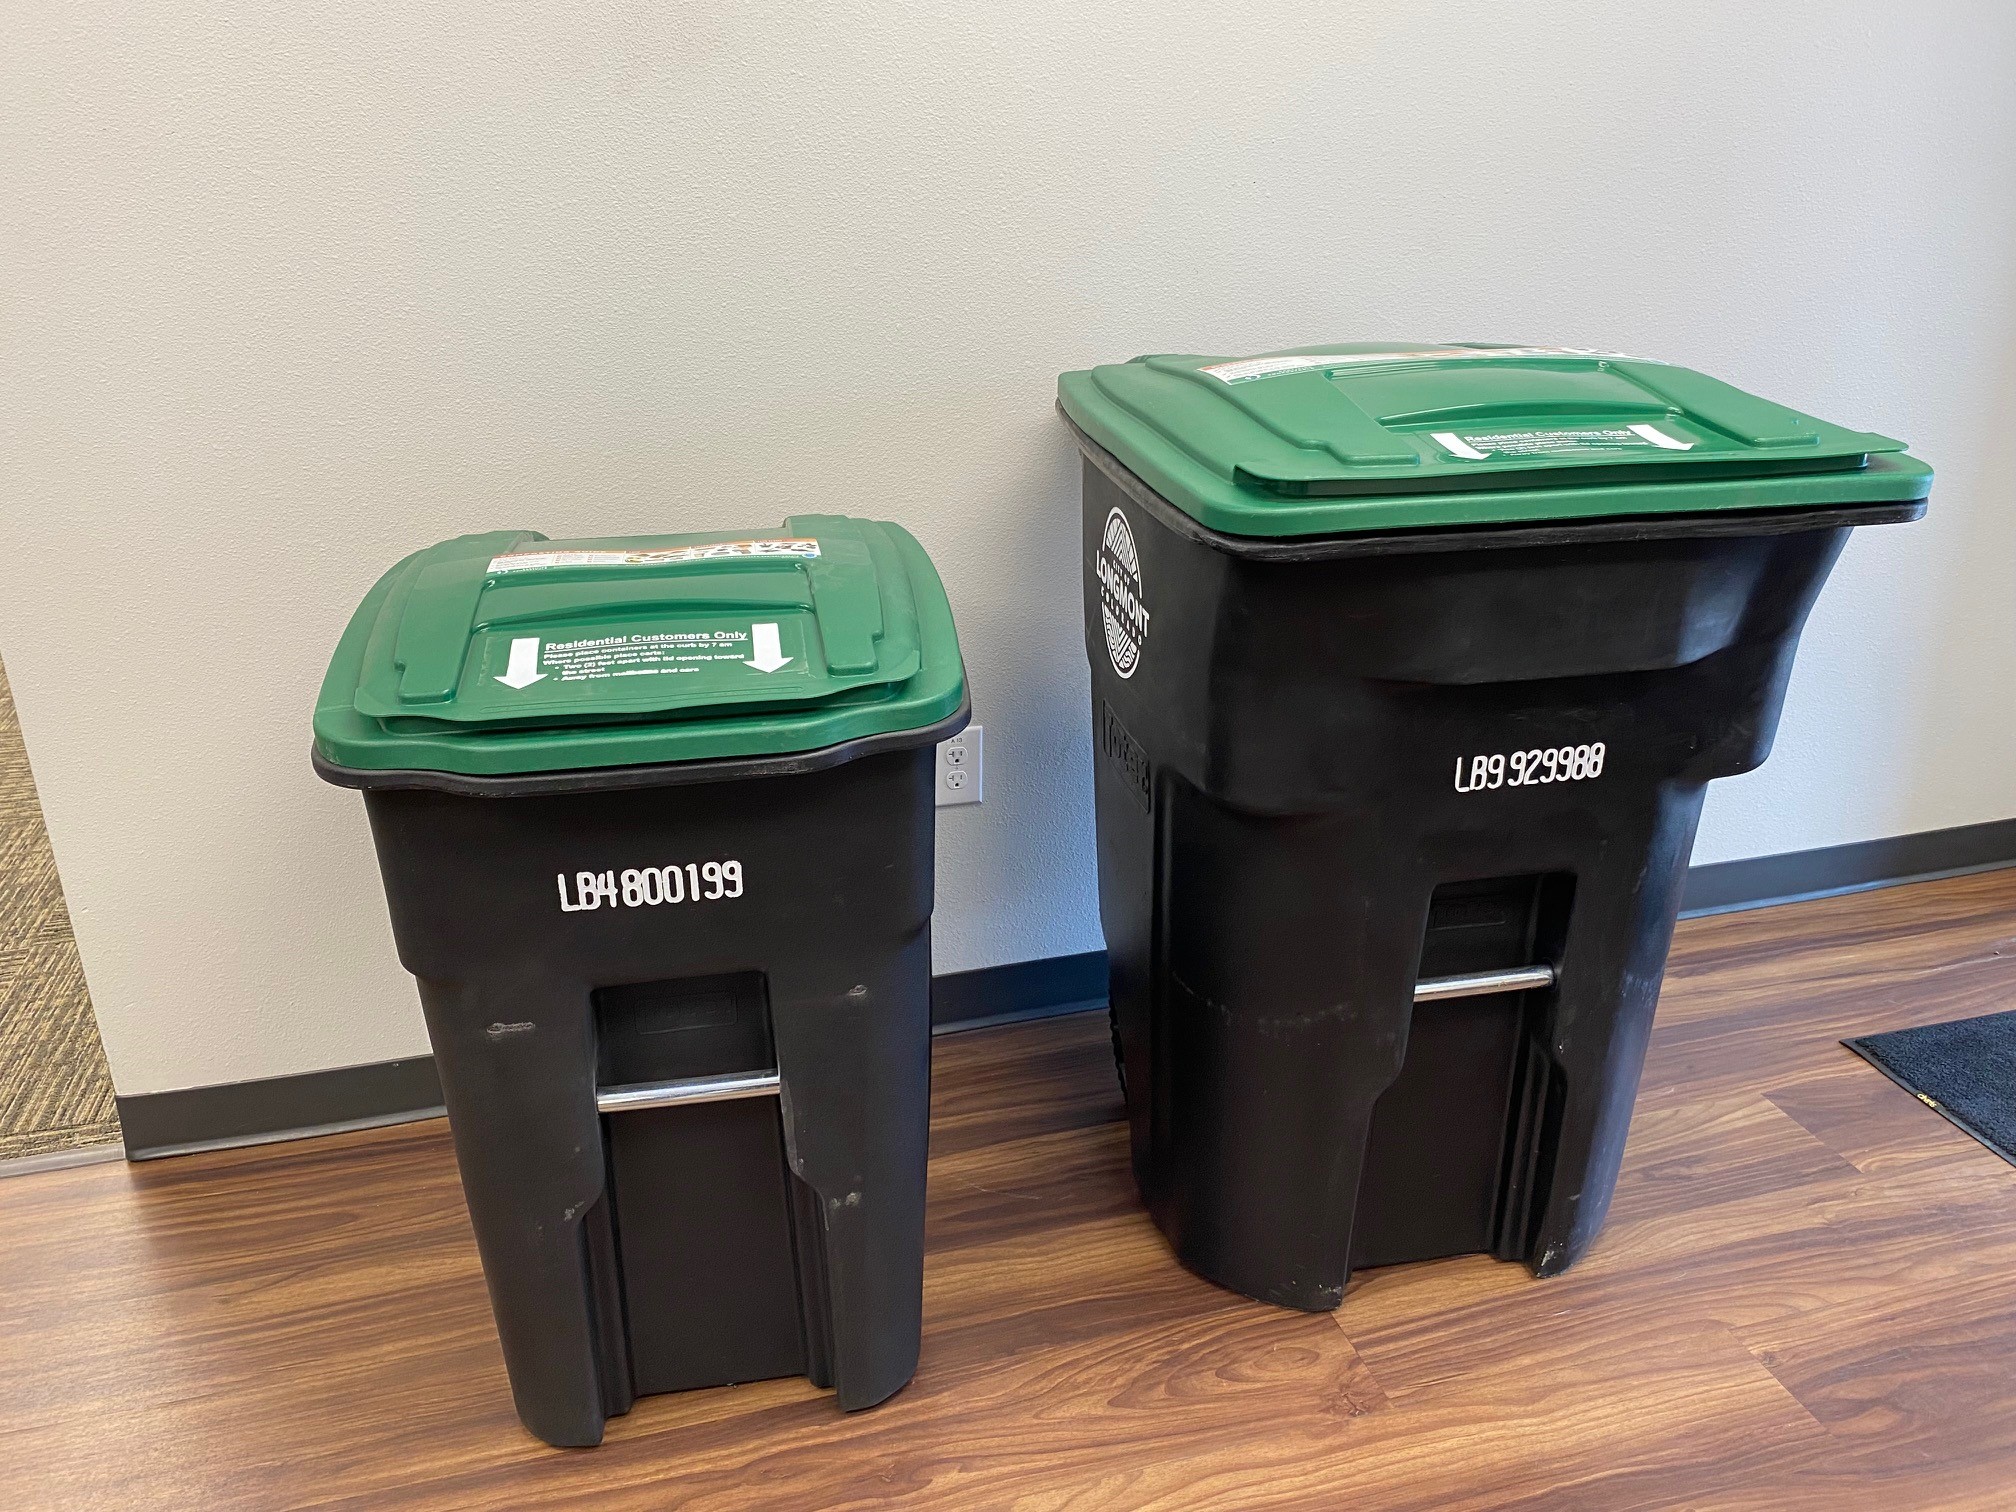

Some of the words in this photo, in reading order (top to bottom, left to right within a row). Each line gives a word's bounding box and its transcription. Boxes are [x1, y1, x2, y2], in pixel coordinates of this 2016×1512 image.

[1464, 432, 1534, 443] Residential
[1096, 549, 1150, 638] LONGMONT
[545, 636, 627, 651] Residential
[631, 631, 710, 643] Customers
[714, 630, 748, 641] Only
